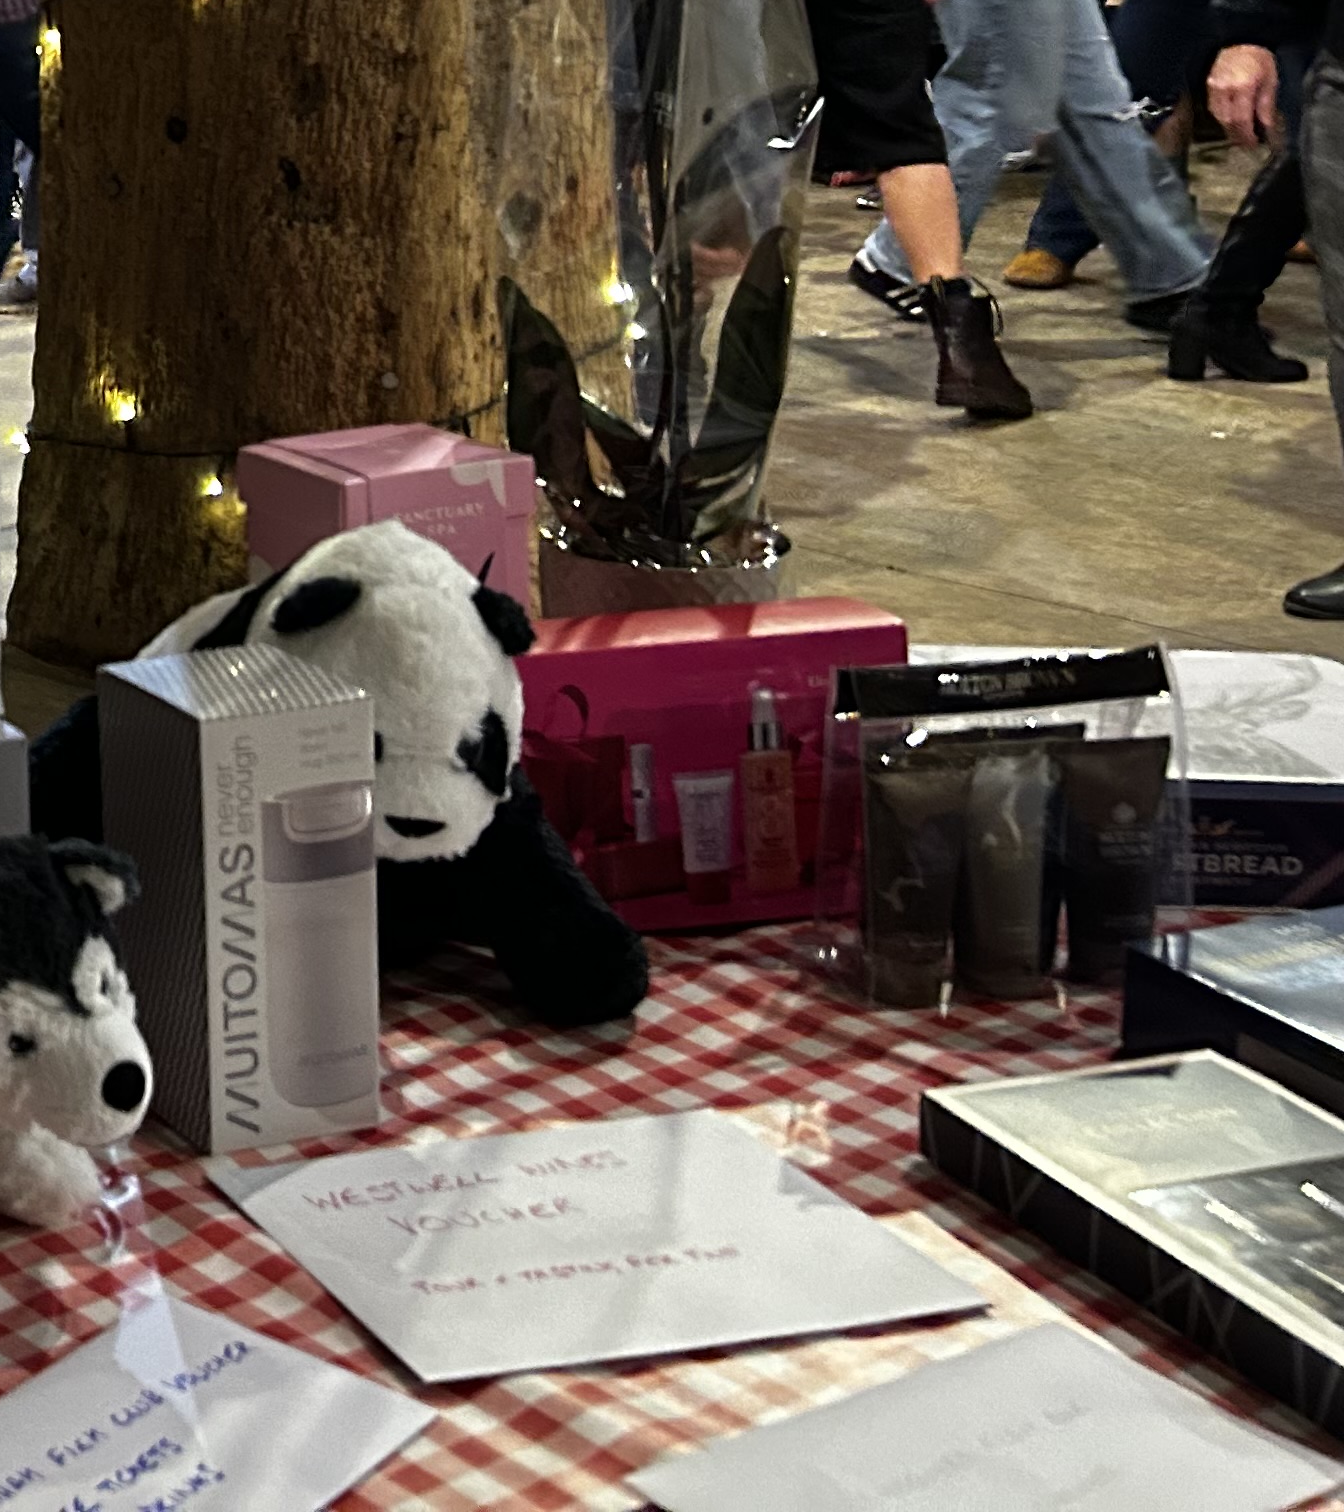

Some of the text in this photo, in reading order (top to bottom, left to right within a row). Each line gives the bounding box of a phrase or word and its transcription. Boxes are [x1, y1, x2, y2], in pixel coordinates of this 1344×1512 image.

[217, 761, 234, 836] never
[302, 1171, 500, 1210] WESTWELL
[386, 1195, 587, 1236] VOUCHER
